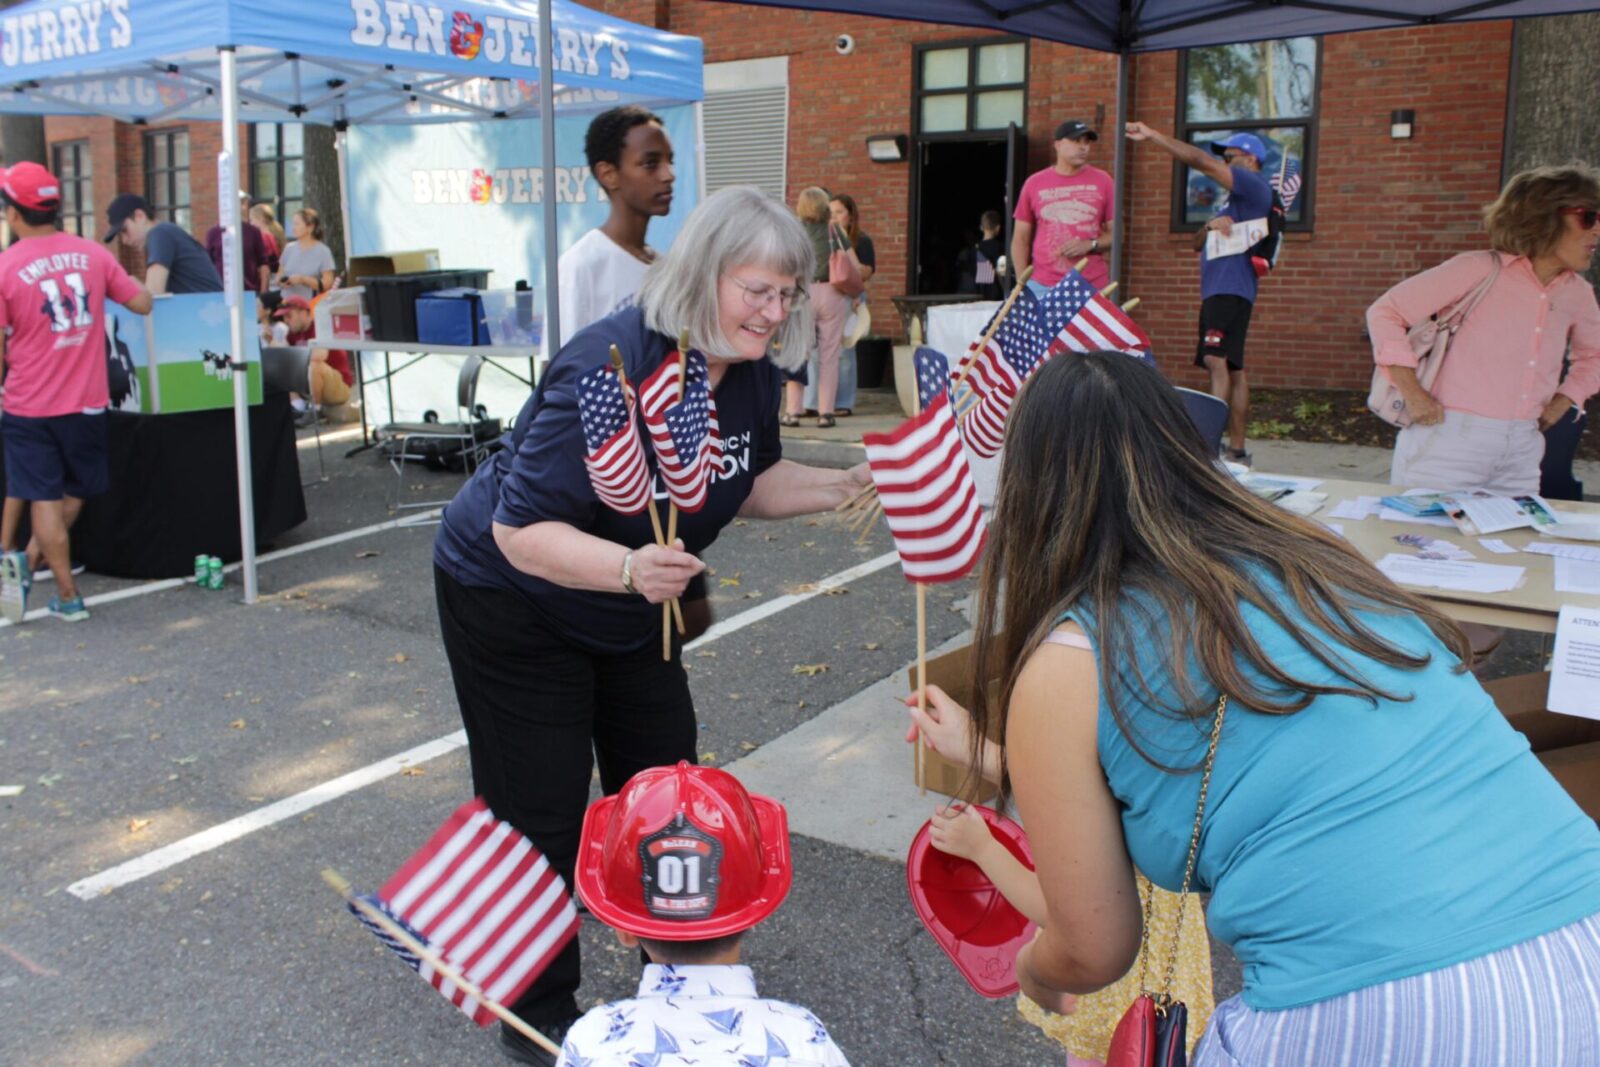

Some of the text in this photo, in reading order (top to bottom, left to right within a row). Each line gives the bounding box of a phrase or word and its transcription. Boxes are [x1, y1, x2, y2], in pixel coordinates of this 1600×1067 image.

[2, 0, 132, 67] JERRY'S
[351, 0, 447, 55] BEN
[411, 168, 468, 205] BEN
[492, 166, 609, 204] JERRY
[17, 252, 89, 286] EMPLOYEE
[40, 272, 93, 331] 11
[1572, 617, 1600, 627] ATTEN
[658, 855, 700, 893] 01
